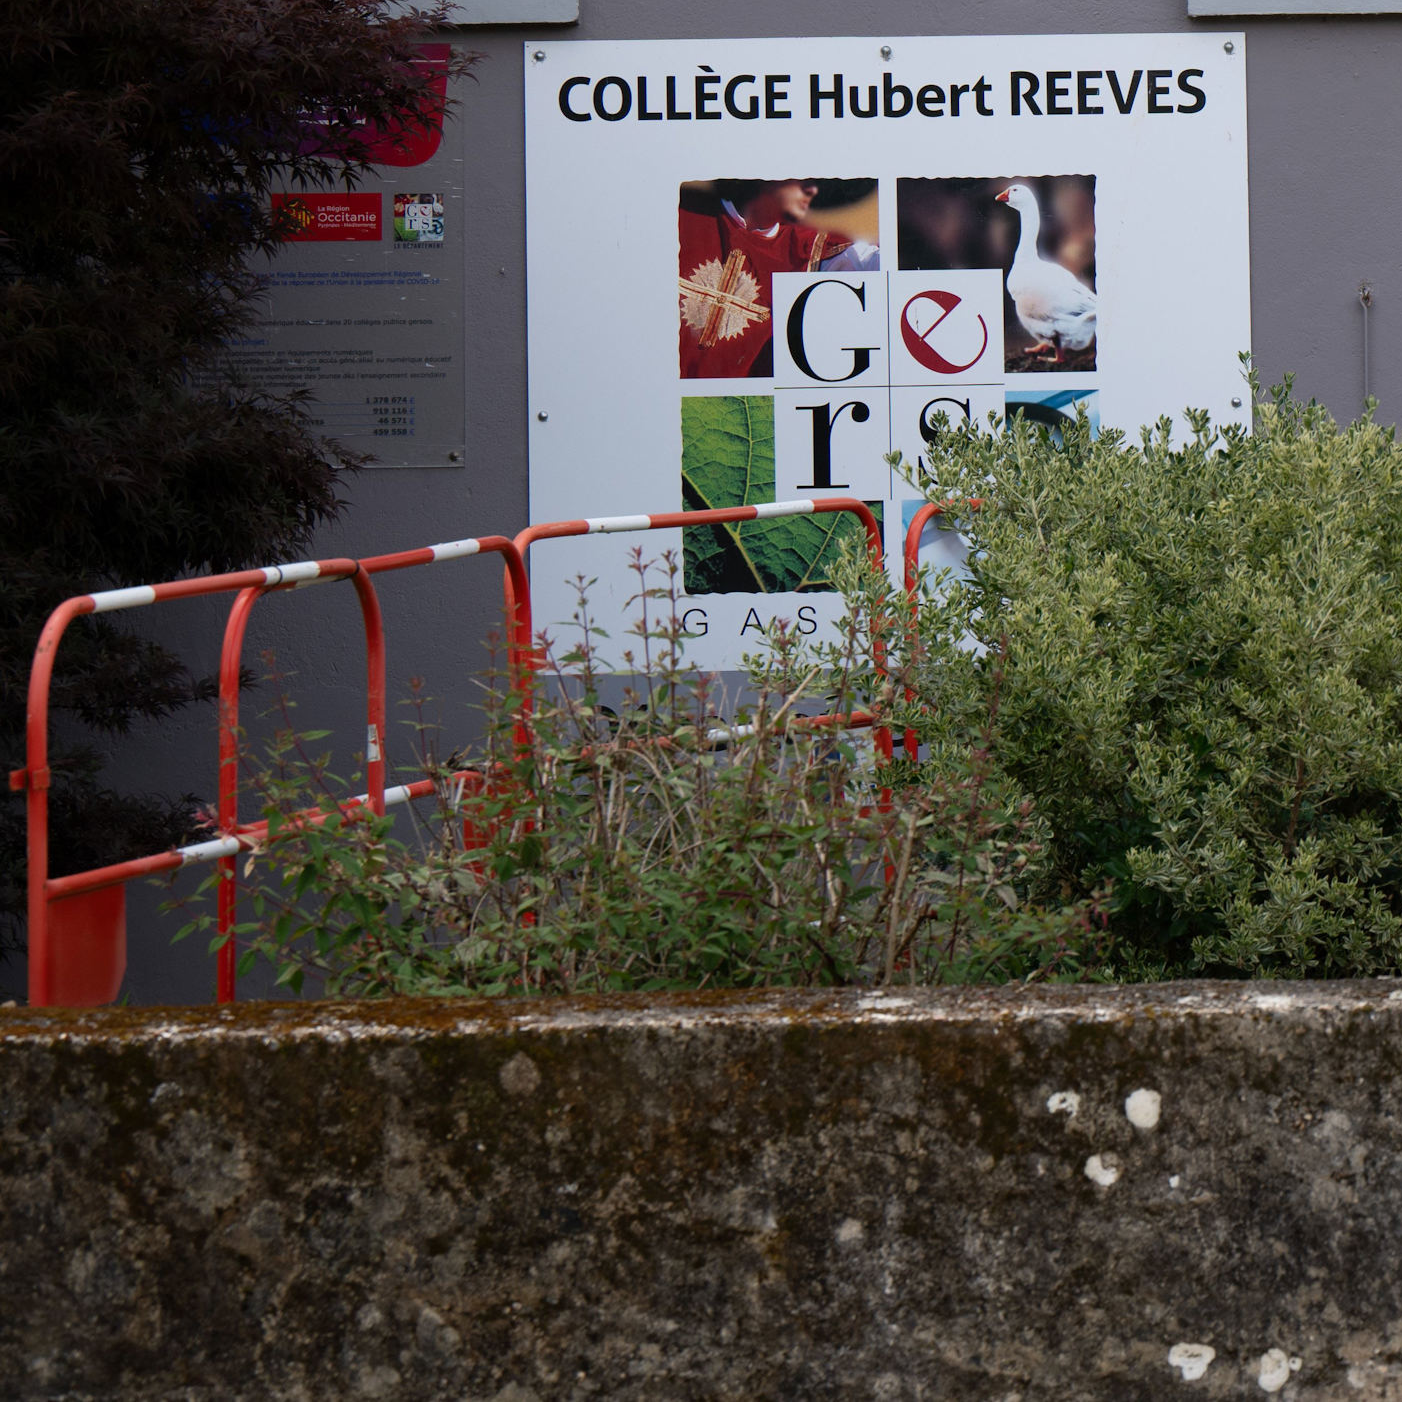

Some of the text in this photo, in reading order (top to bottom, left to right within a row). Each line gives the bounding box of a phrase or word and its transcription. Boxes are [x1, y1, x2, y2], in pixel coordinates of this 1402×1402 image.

[558, 65, 1207, 122] COLLÈGE Hubert REEVES
[326, 205, 350, 213] Région
[317, 212, 377, 223] Occitanie
